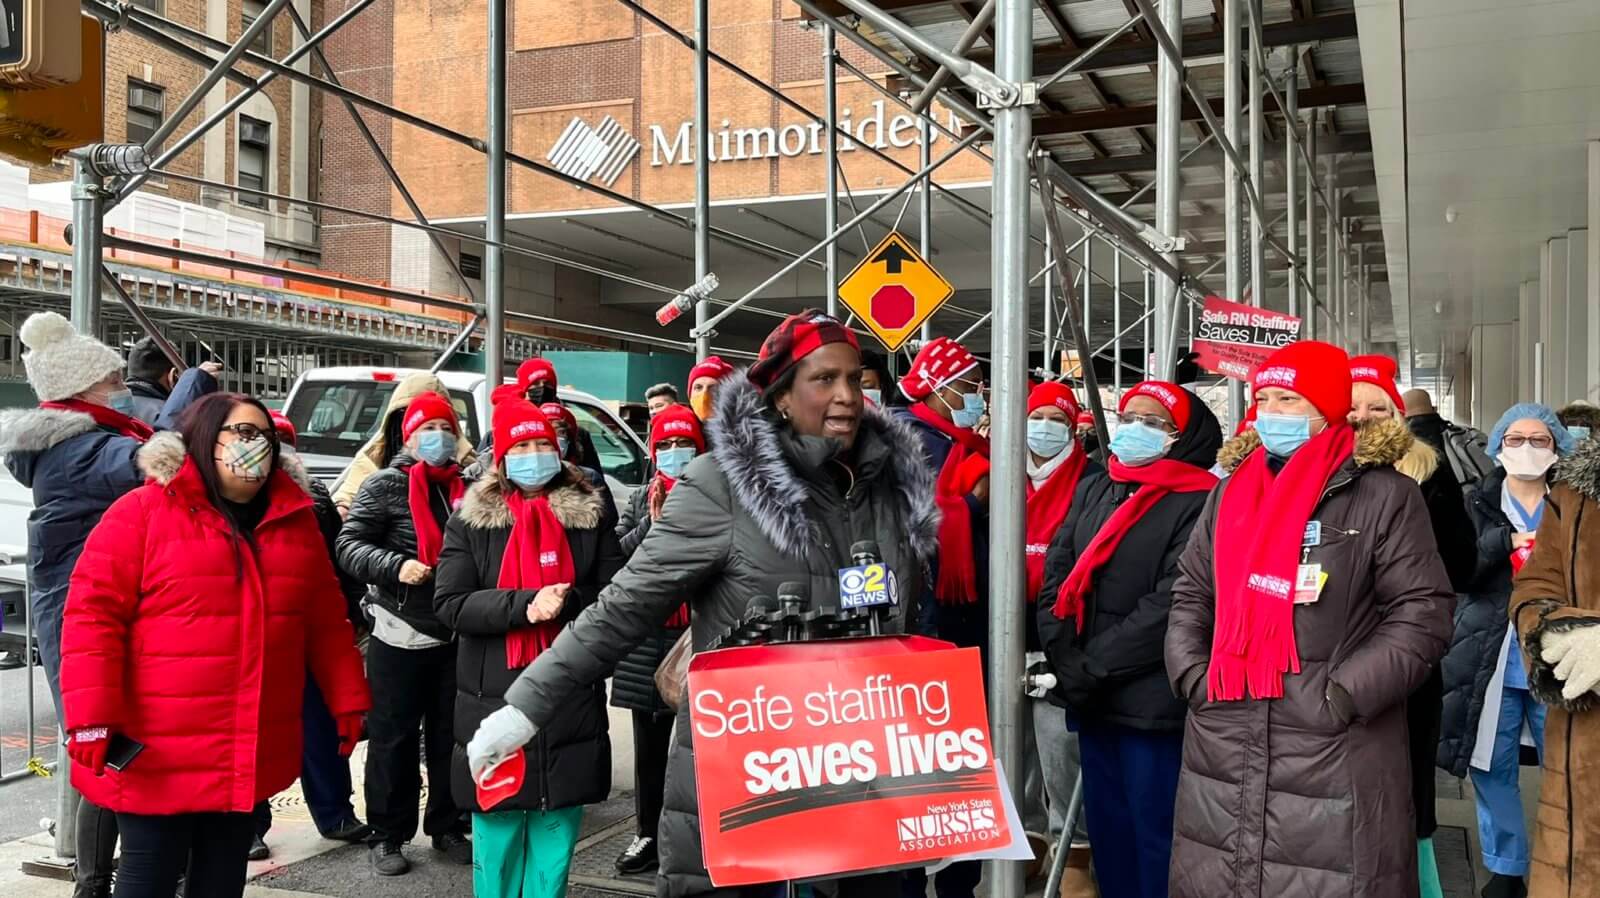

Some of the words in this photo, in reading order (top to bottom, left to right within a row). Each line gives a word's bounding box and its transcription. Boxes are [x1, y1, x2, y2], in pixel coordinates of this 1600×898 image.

[1198, 322, 1250, 343] Saves
[1253, 327, 1298, 346] Lives
[1202, 309, 1228, 324] Safe
[1230, 312, 1250, 326] RN
[1251, 314, 1300, 334] Staffing
[864, 564, 886, 593] 2
[842, 590, 887, 607] NEWS
[695, 684, 794, 738] Safe
[804, 673, 951, 726] staffing
[743, 738, 877, 795] saves
[884, 723, 988, 778] lives
[927, 805, 948, 815] New
[948, 800, 969, 812] York
[970, 799, 992, 809] State
[897, 808, 995, 841] NURSES
[899, 829, 999, 851] ASSOCIATION
